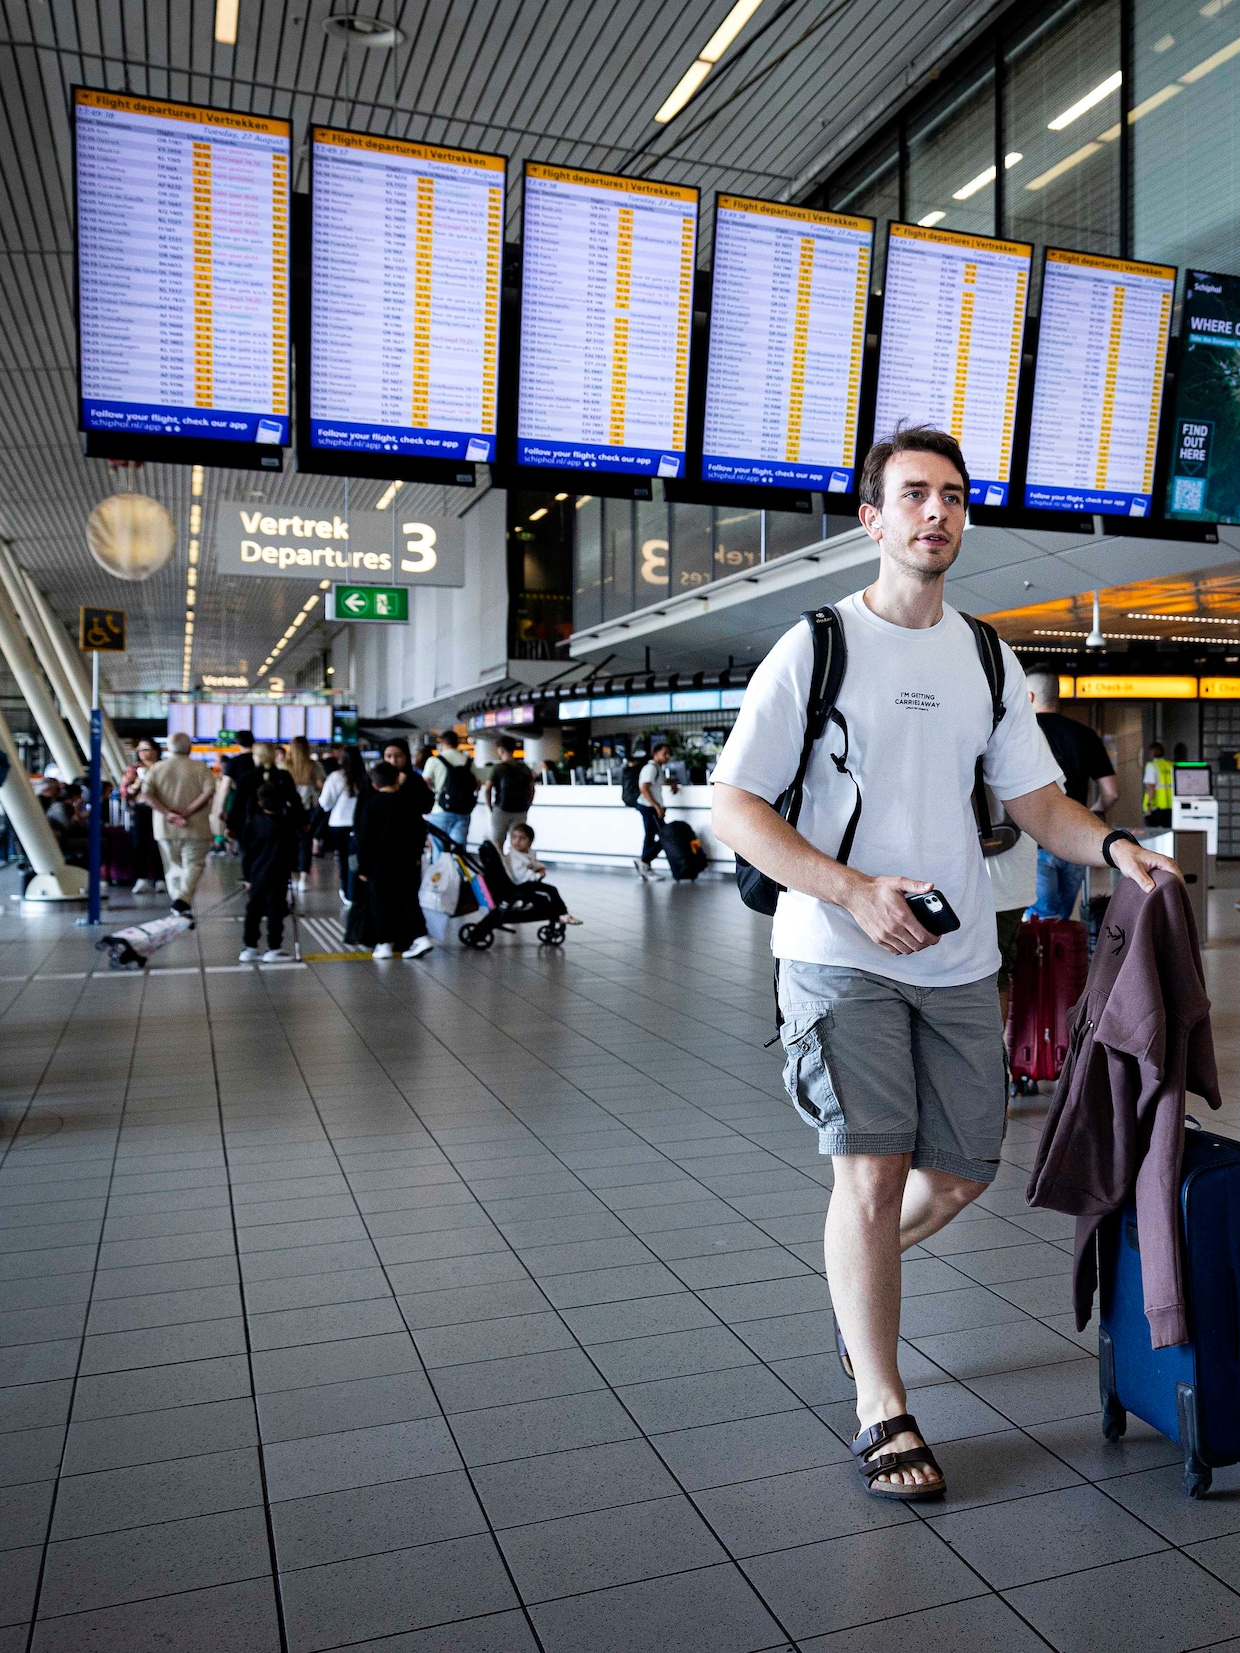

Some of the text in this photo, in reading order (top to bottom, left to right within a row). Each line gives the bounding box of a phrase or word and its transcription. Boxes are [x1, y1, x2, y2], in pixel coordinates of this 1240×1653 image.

[96, 95, 268, 130] Flight departures Vertrekken
[332, 133, 486, 166] Flight departures Vertrekken
[543, 168, 681, 197] Flight departures Vertrekken
[668, 202, 692, 210] August
[733, 200, 858, 227] Flight departures Vertrekken
[846, 231, 869, 239] August
[904, 228, 1017, 252] Flight departures Vertrekken
[1194, 282, 1222, 294] Schiphol
[1191, 316, 1233, 334] WHERE
[91, 409, 124, 419] Follow
[151, 414, 180, 424] flight,
[182, 417, 209, 426] check
[229, 422, 248, 430] app
[318, 429, 348, 438] Follow
[372, 433, 398, 443] flight,
[399, 436, 424, 445] check
[442, 440, 459, 449] app
[1182, 423, 1208, 437] FIND
[1183, 436, 1205, 448] OUT
[524, 447, 551, 456] Follow
[573, 451, 596, 460] flight,
[598, 453, 620, 462] check
[636, 457, 651, 465] app
[1180, 448, 1206, 461] HERE
[708, 463, 733, 472] Follow
[752, 467, 774, 476] flight,
[774, 470, 795, 478] check
[240, 510, 349, 540] Vertrek
[240, 540, 392, 570] Departures
[400, 522, 437, 573] 3
[911, 692, 935, 700] GETTING
[1096, 682, 1133, 692] Check-in
